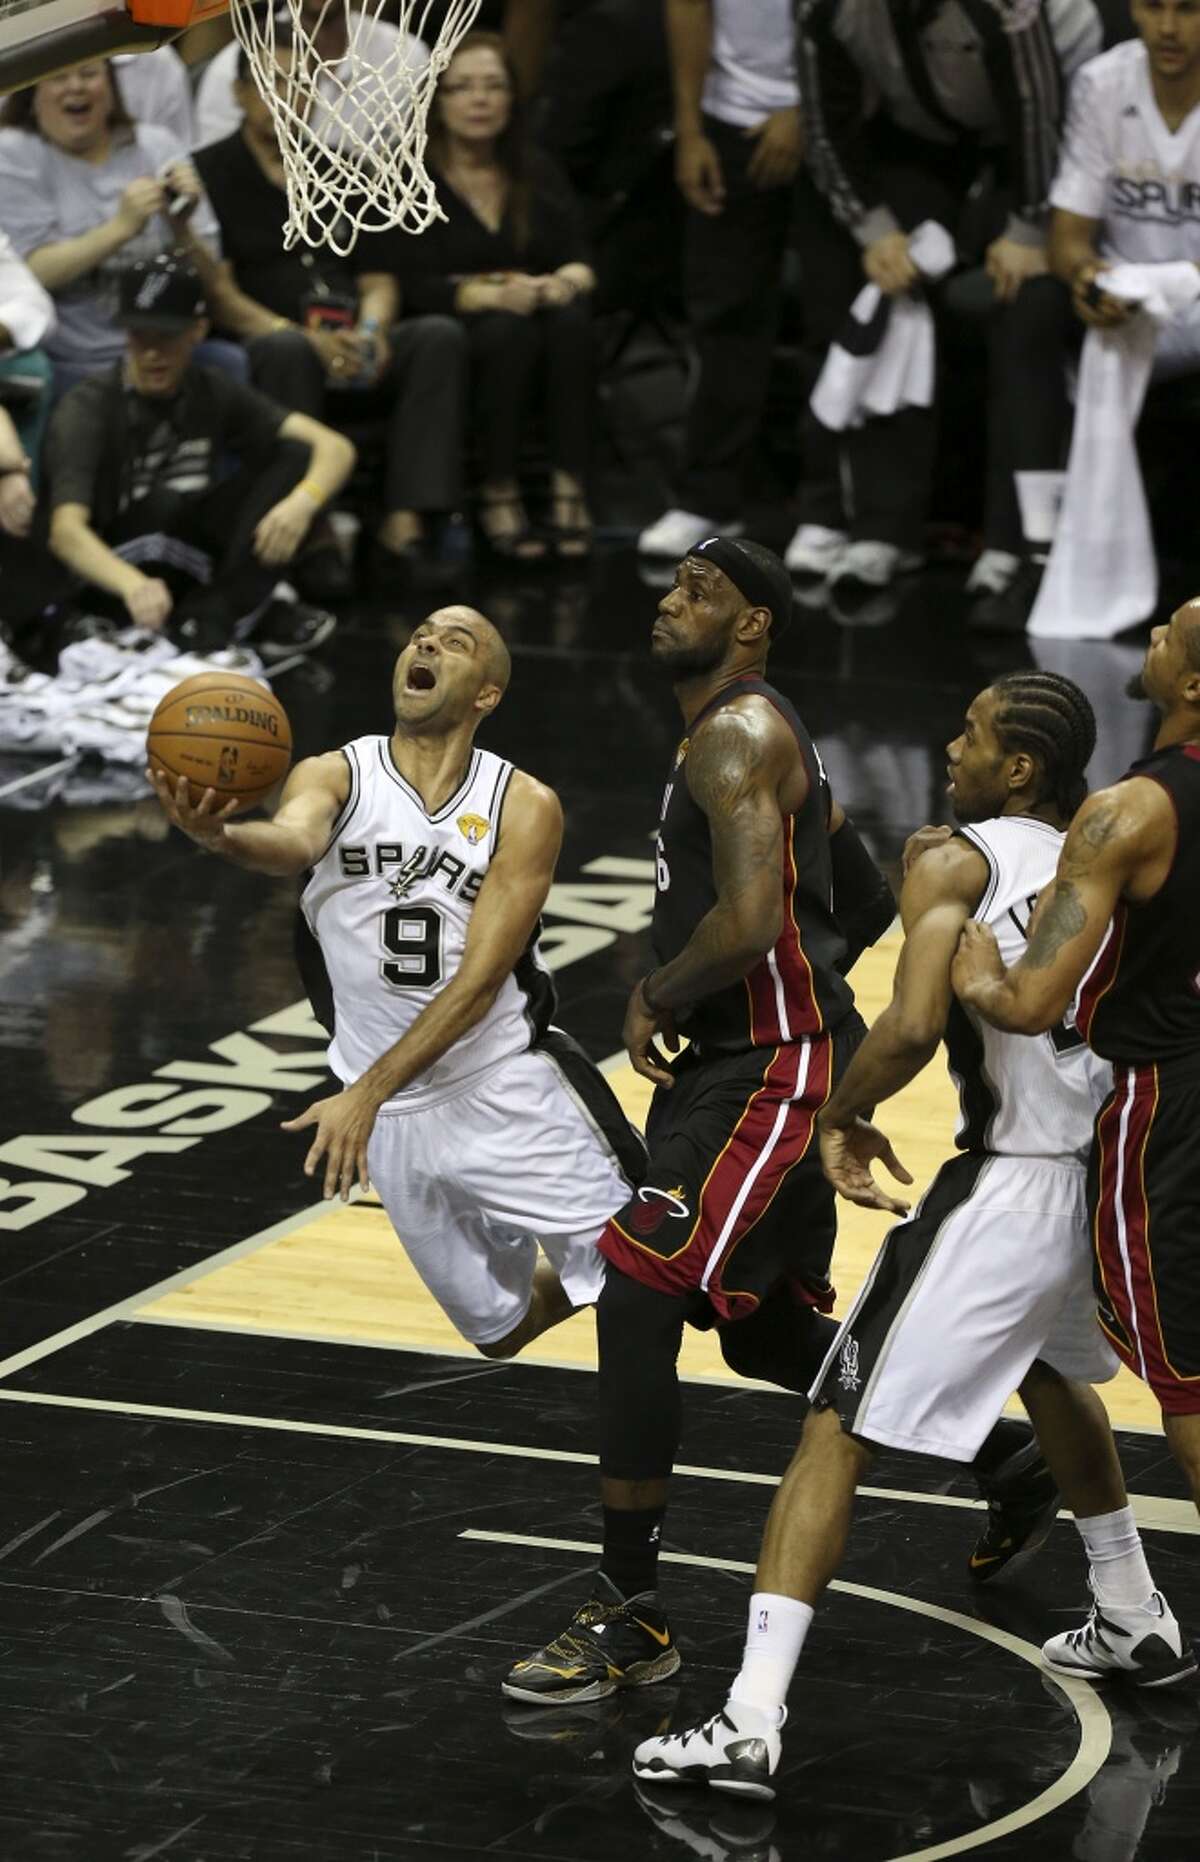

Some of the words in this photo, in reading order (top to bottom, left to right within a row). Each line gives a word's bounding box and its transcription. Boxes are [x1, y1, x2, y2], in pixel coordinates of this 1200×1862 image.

[184, 704, 279, 738] SPALDING
[339, 842, 485, 902] SPURS
[381, 904, 443, 988] 9
